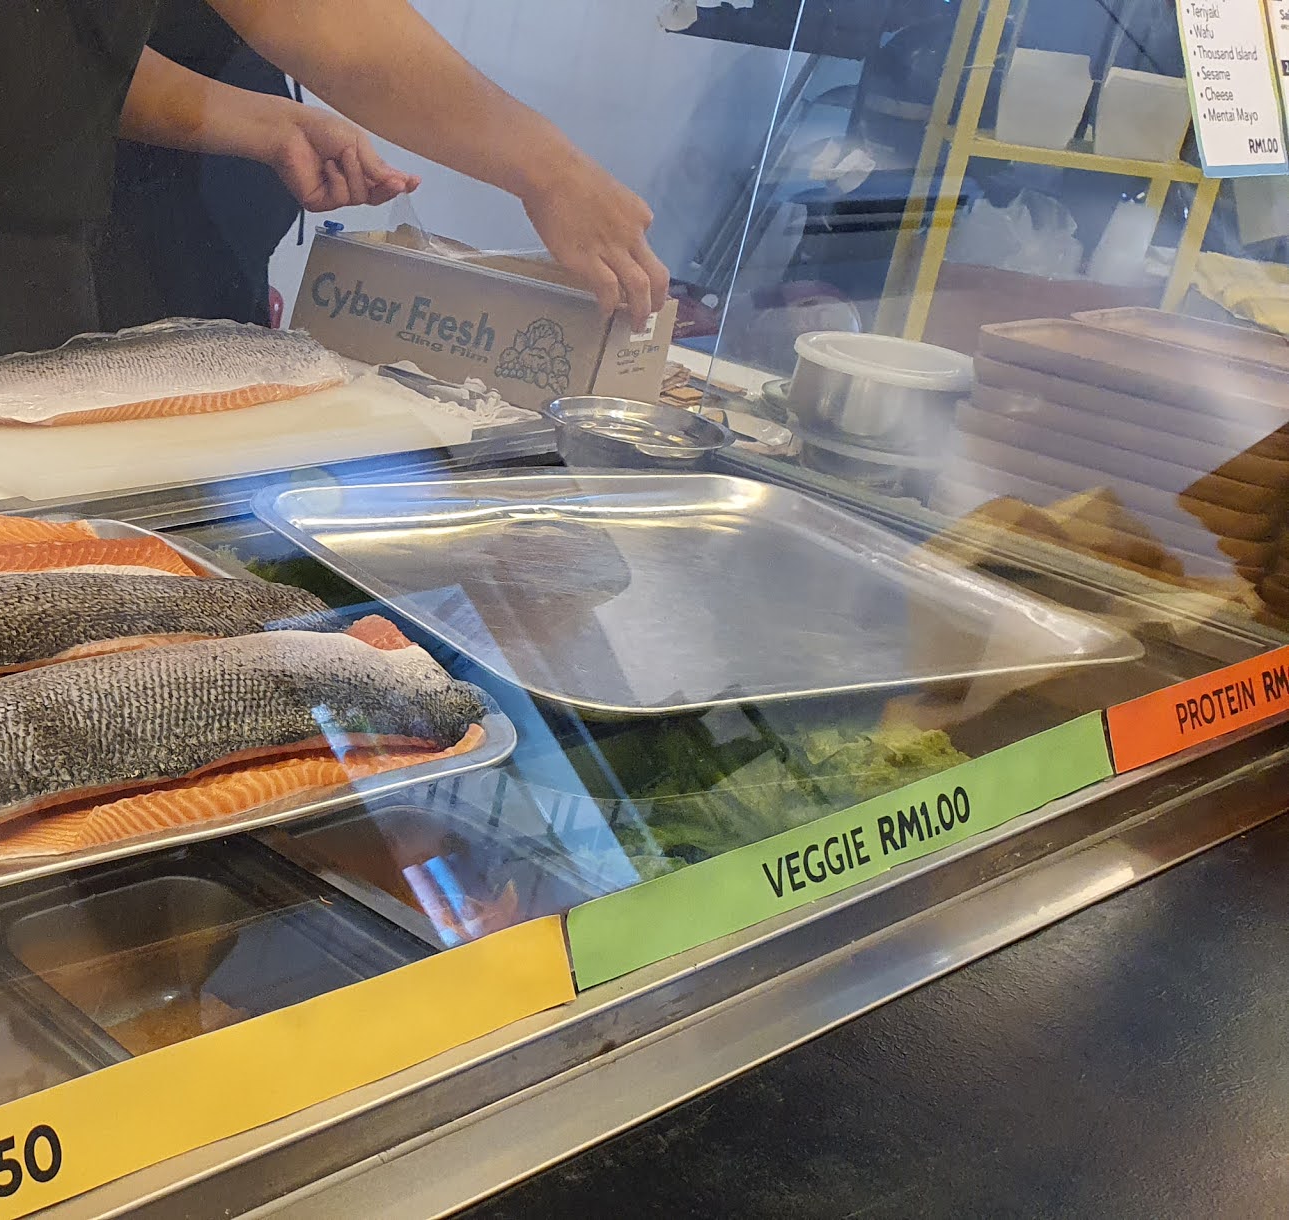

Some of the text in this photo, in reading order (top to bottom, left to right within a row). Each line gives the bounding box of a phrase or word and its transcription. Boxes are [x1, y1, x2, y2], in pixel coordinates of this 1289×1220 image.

[1191, 3, 1221, 21] Teriyaki
[1193, 24, 1215, 39] Wafu
[1197, 45, 1258, 60] Thousand Island
[1201, 66, 1231, 80] Sesame
[1205, 86, 1234, 101] Cheese
[1207, 108, 1259, 125] Mentai Mayo
[1248, 138, 1279, 154] RM1.00
[312, 271, 496, 351] Cyber Fresh
[397, 331, 443, 352] Cling
[1175, 665, 1289, 734] PROTEIN RM
[762, 786, 970, 898] VEGGIE RM1.00
